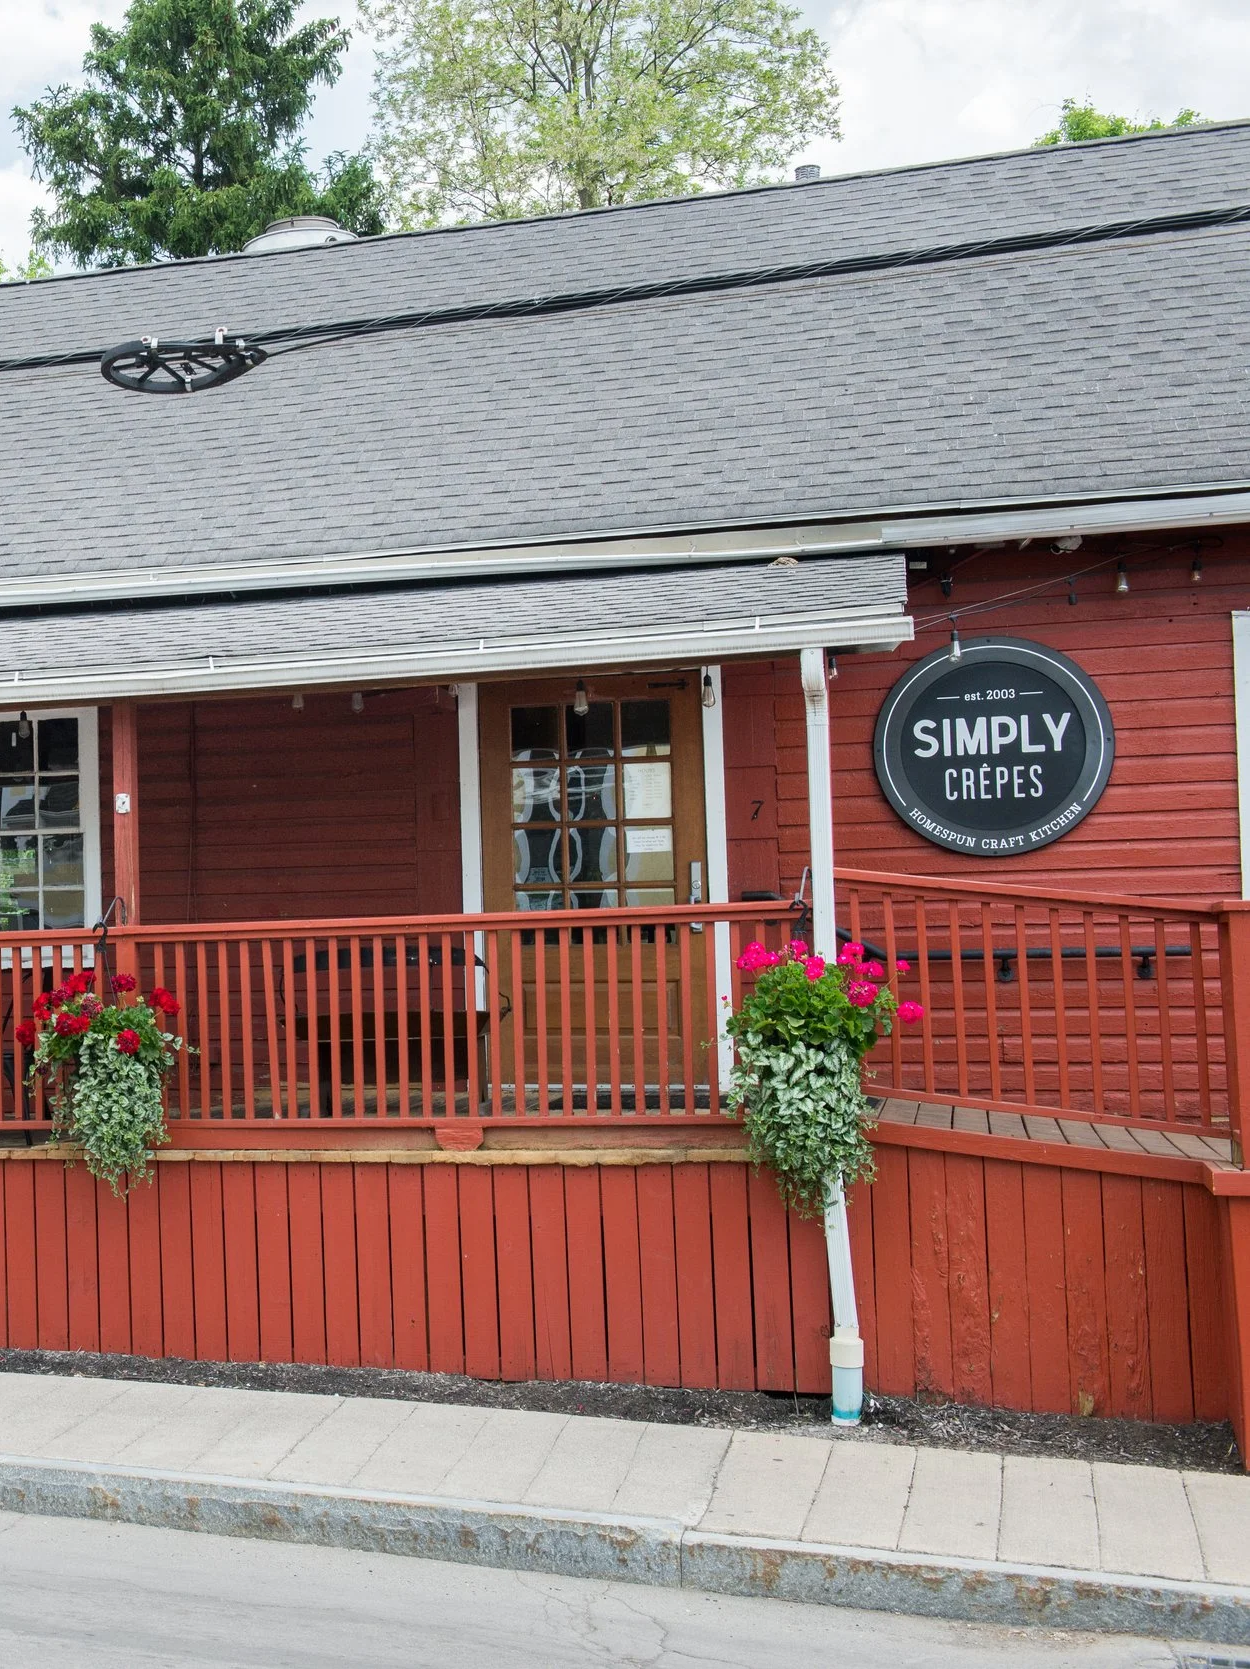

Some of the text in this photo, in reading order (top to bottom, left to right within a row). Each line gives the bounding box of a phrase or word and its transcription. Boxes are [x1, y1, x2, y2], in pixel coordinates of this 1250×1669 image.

[964, 688, 1016, 701] est. 2003
[912, 712, 1072, 758] SIMPLY
[944, 763, 1044, 801] CRÊPES
[750, 800, 765, 821] 7
[909, 802, 1082, 849] HOMESPUN CRAFT KITCHEN
